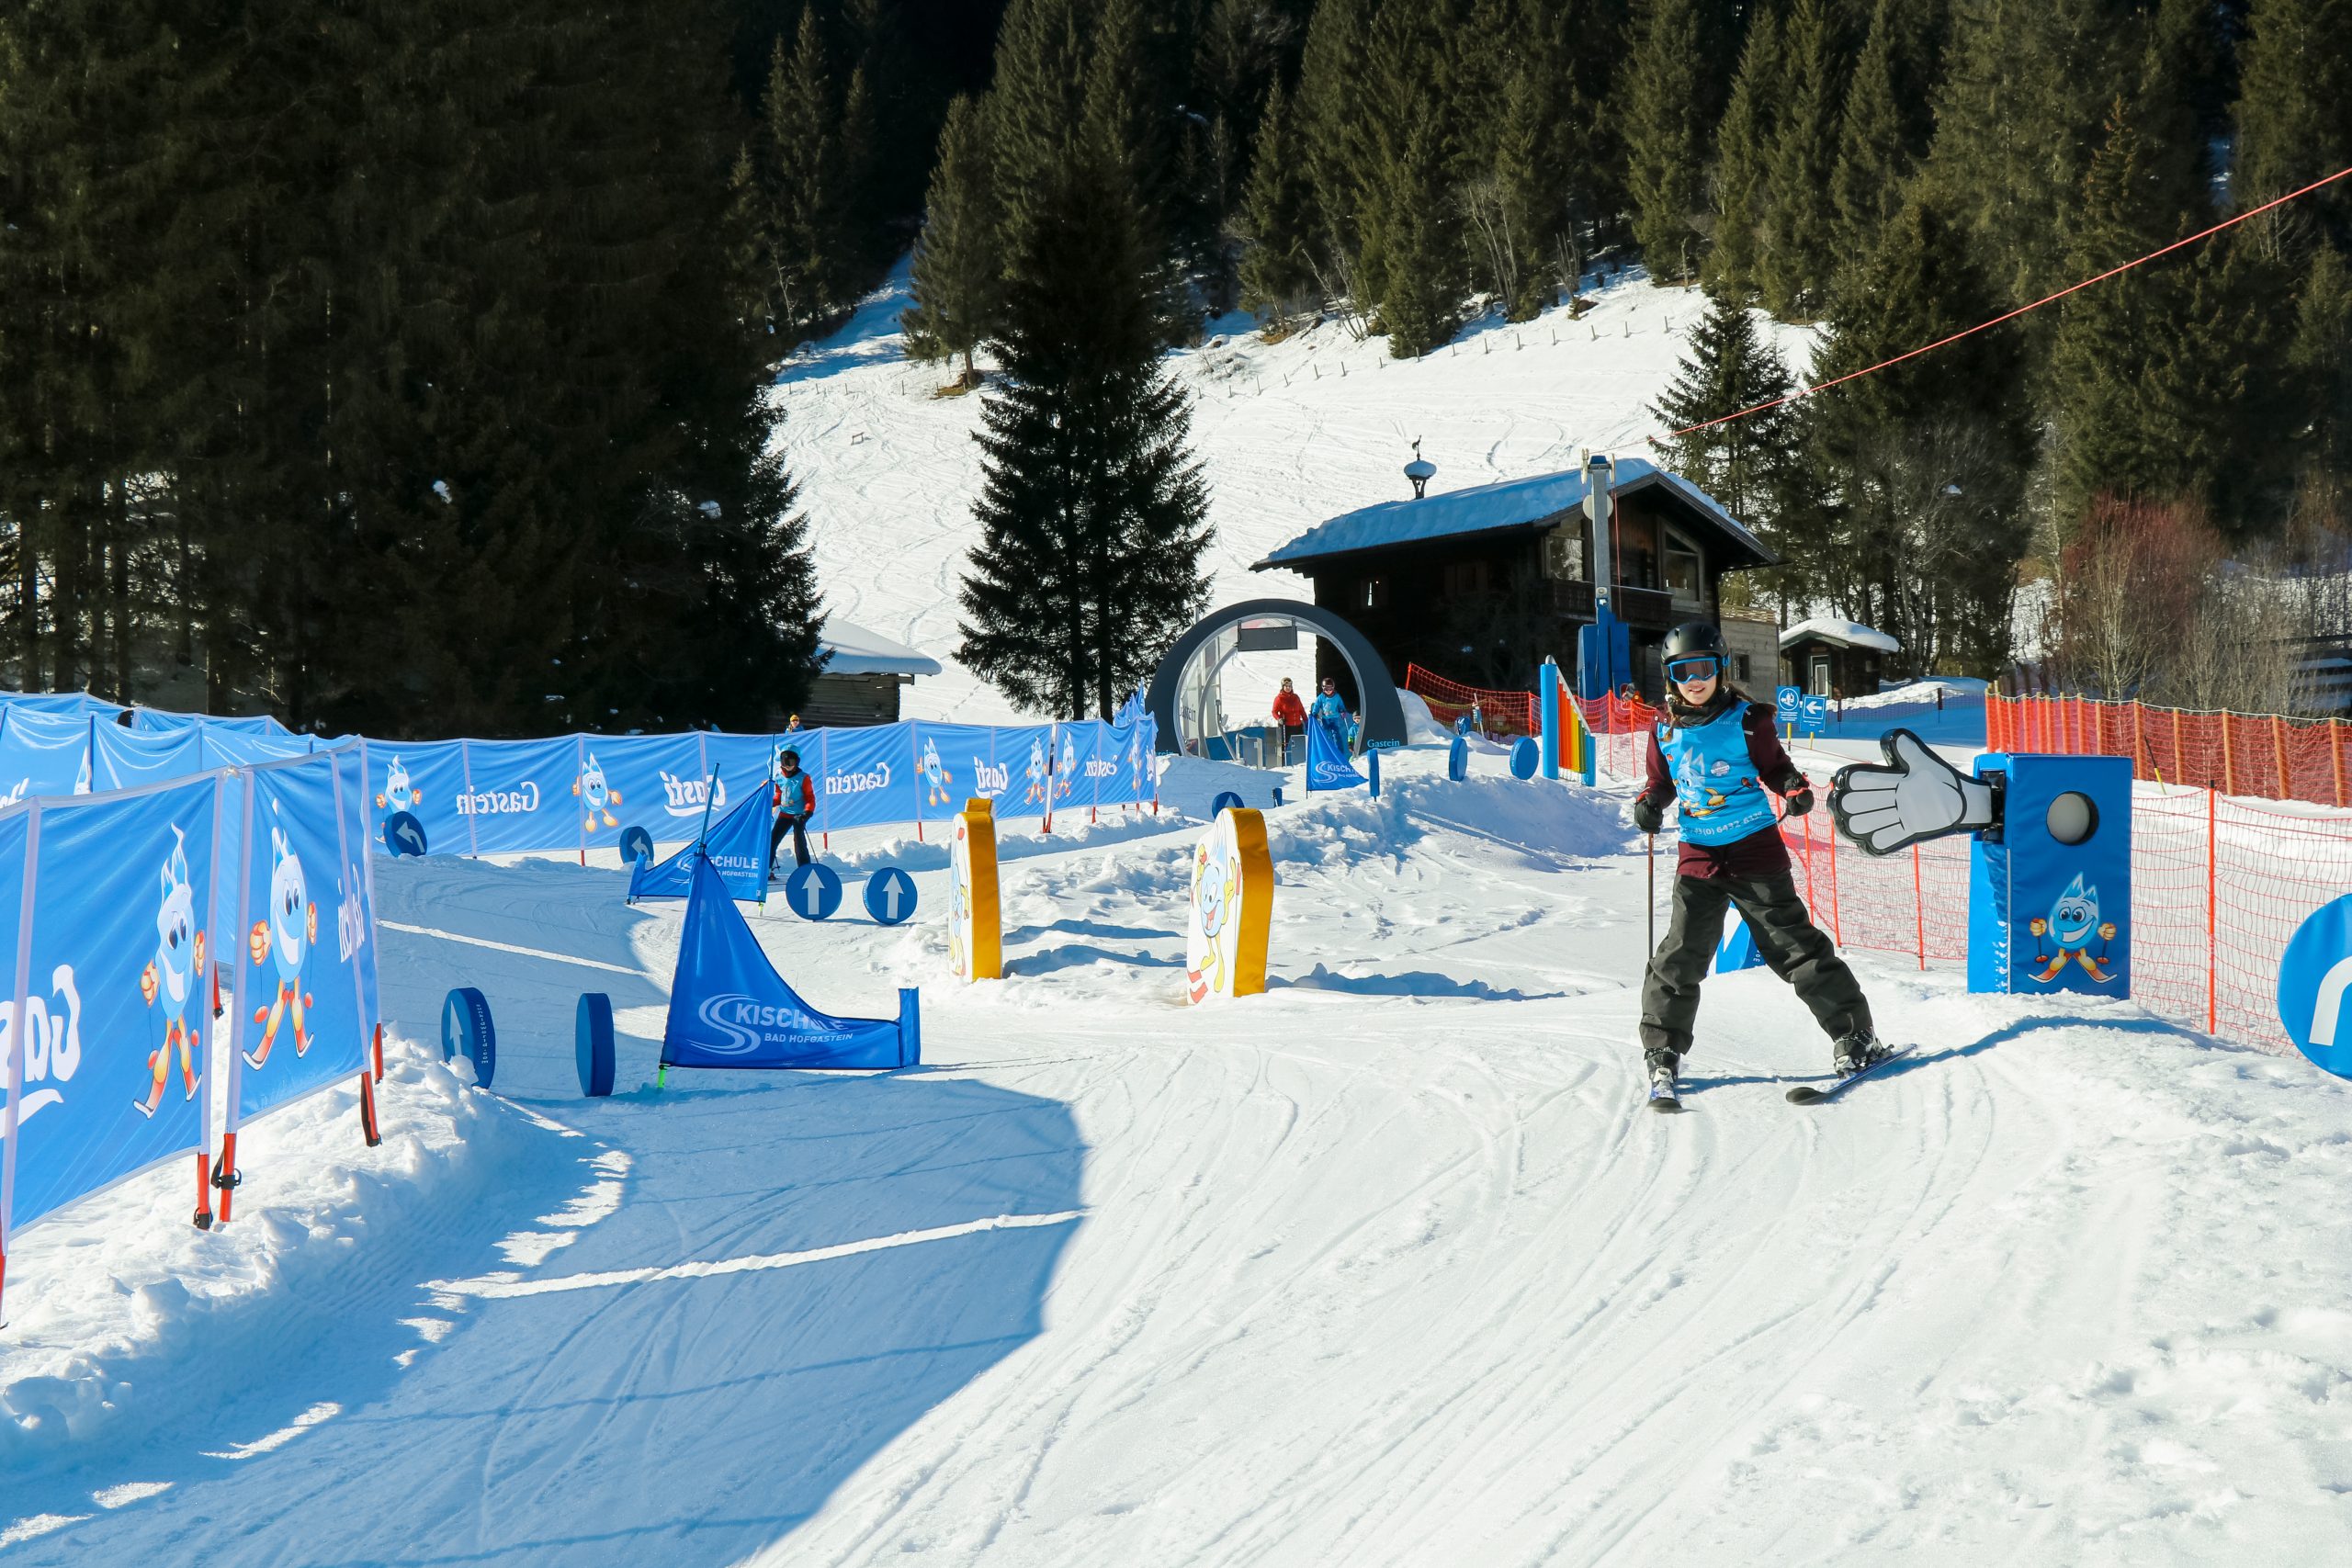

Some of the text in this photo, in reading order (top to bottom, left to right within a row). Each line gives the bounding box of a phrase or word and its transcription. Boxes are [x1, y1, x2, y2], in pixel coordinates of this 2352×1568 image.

[1367, 739, 1400, 748] Gastein
[764, 1032, 854, 1044] BAD HOFGASTEIN
